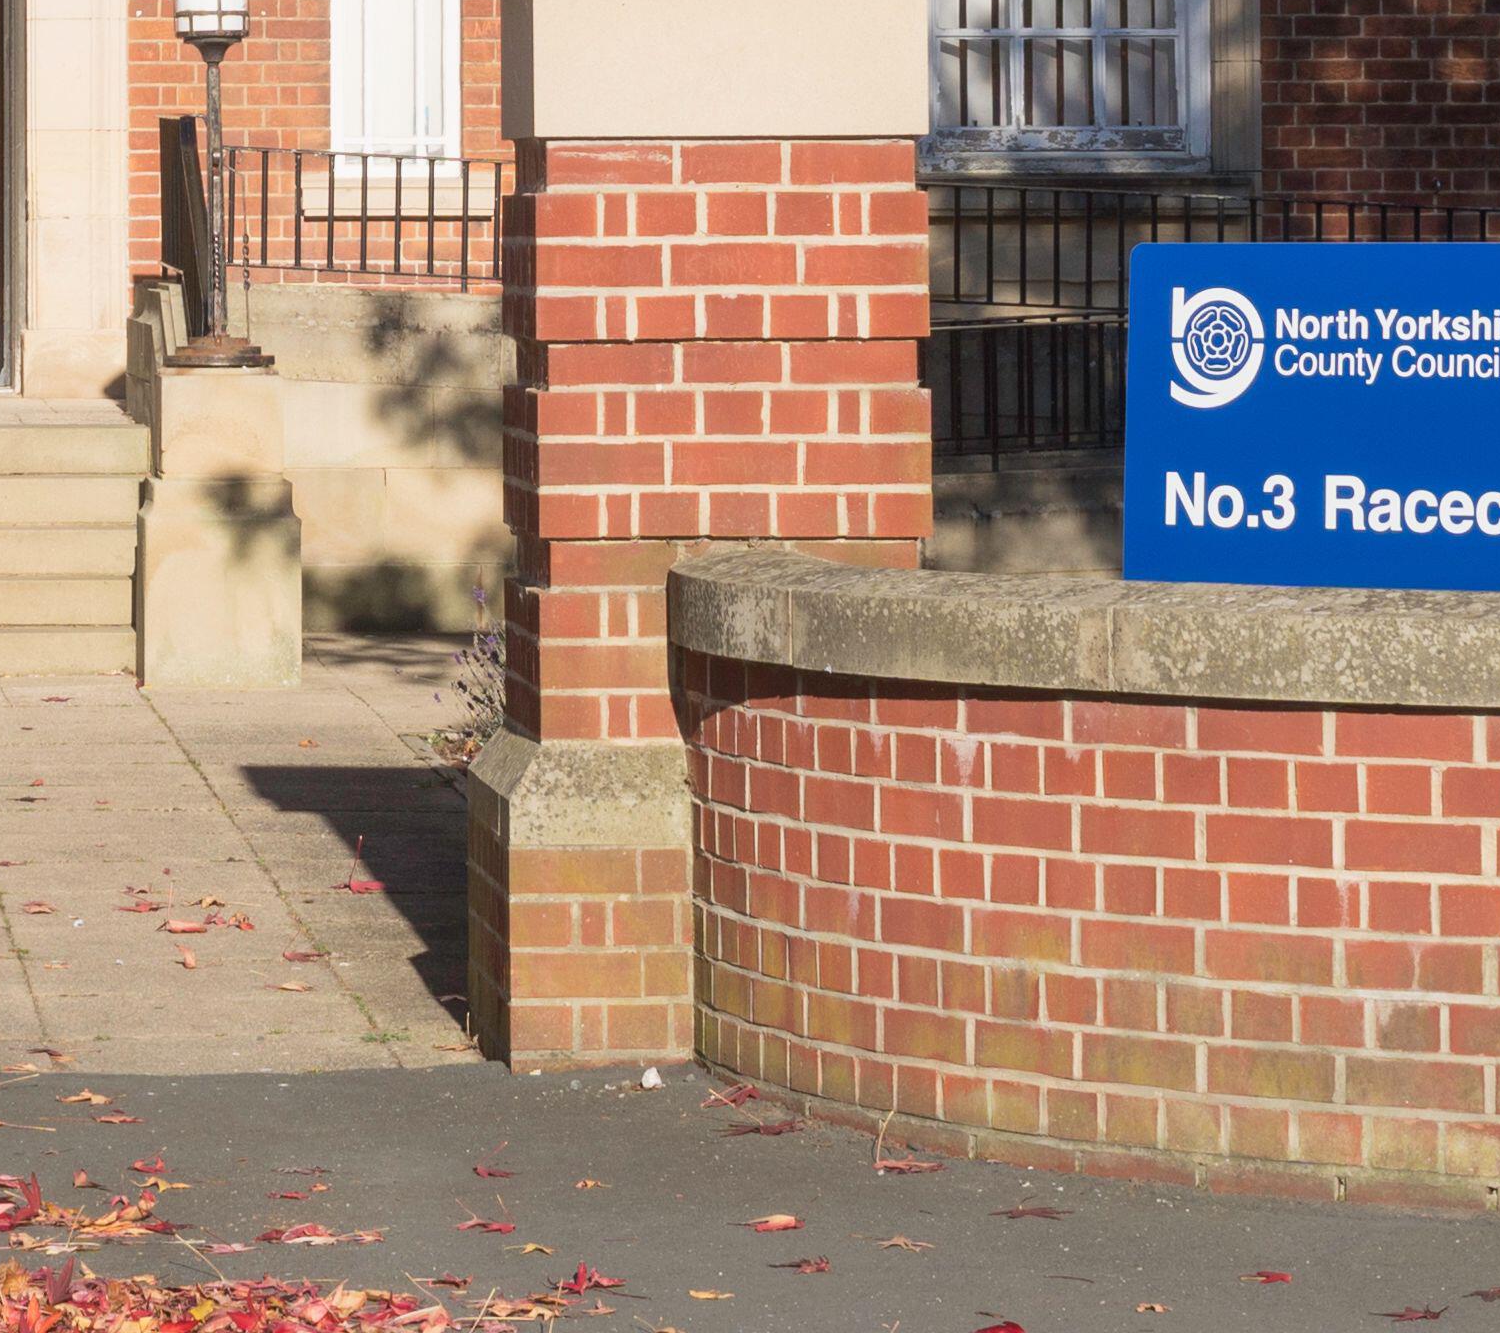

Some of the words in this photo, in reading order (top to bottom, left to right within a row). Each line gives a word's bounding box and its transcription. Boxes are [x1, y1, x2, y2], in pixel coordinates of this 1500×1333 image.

[1275, 308, 1370, 341] North
[1274, 344, 1384, 385] County
[1164, 471, 1296, 530] No.3
